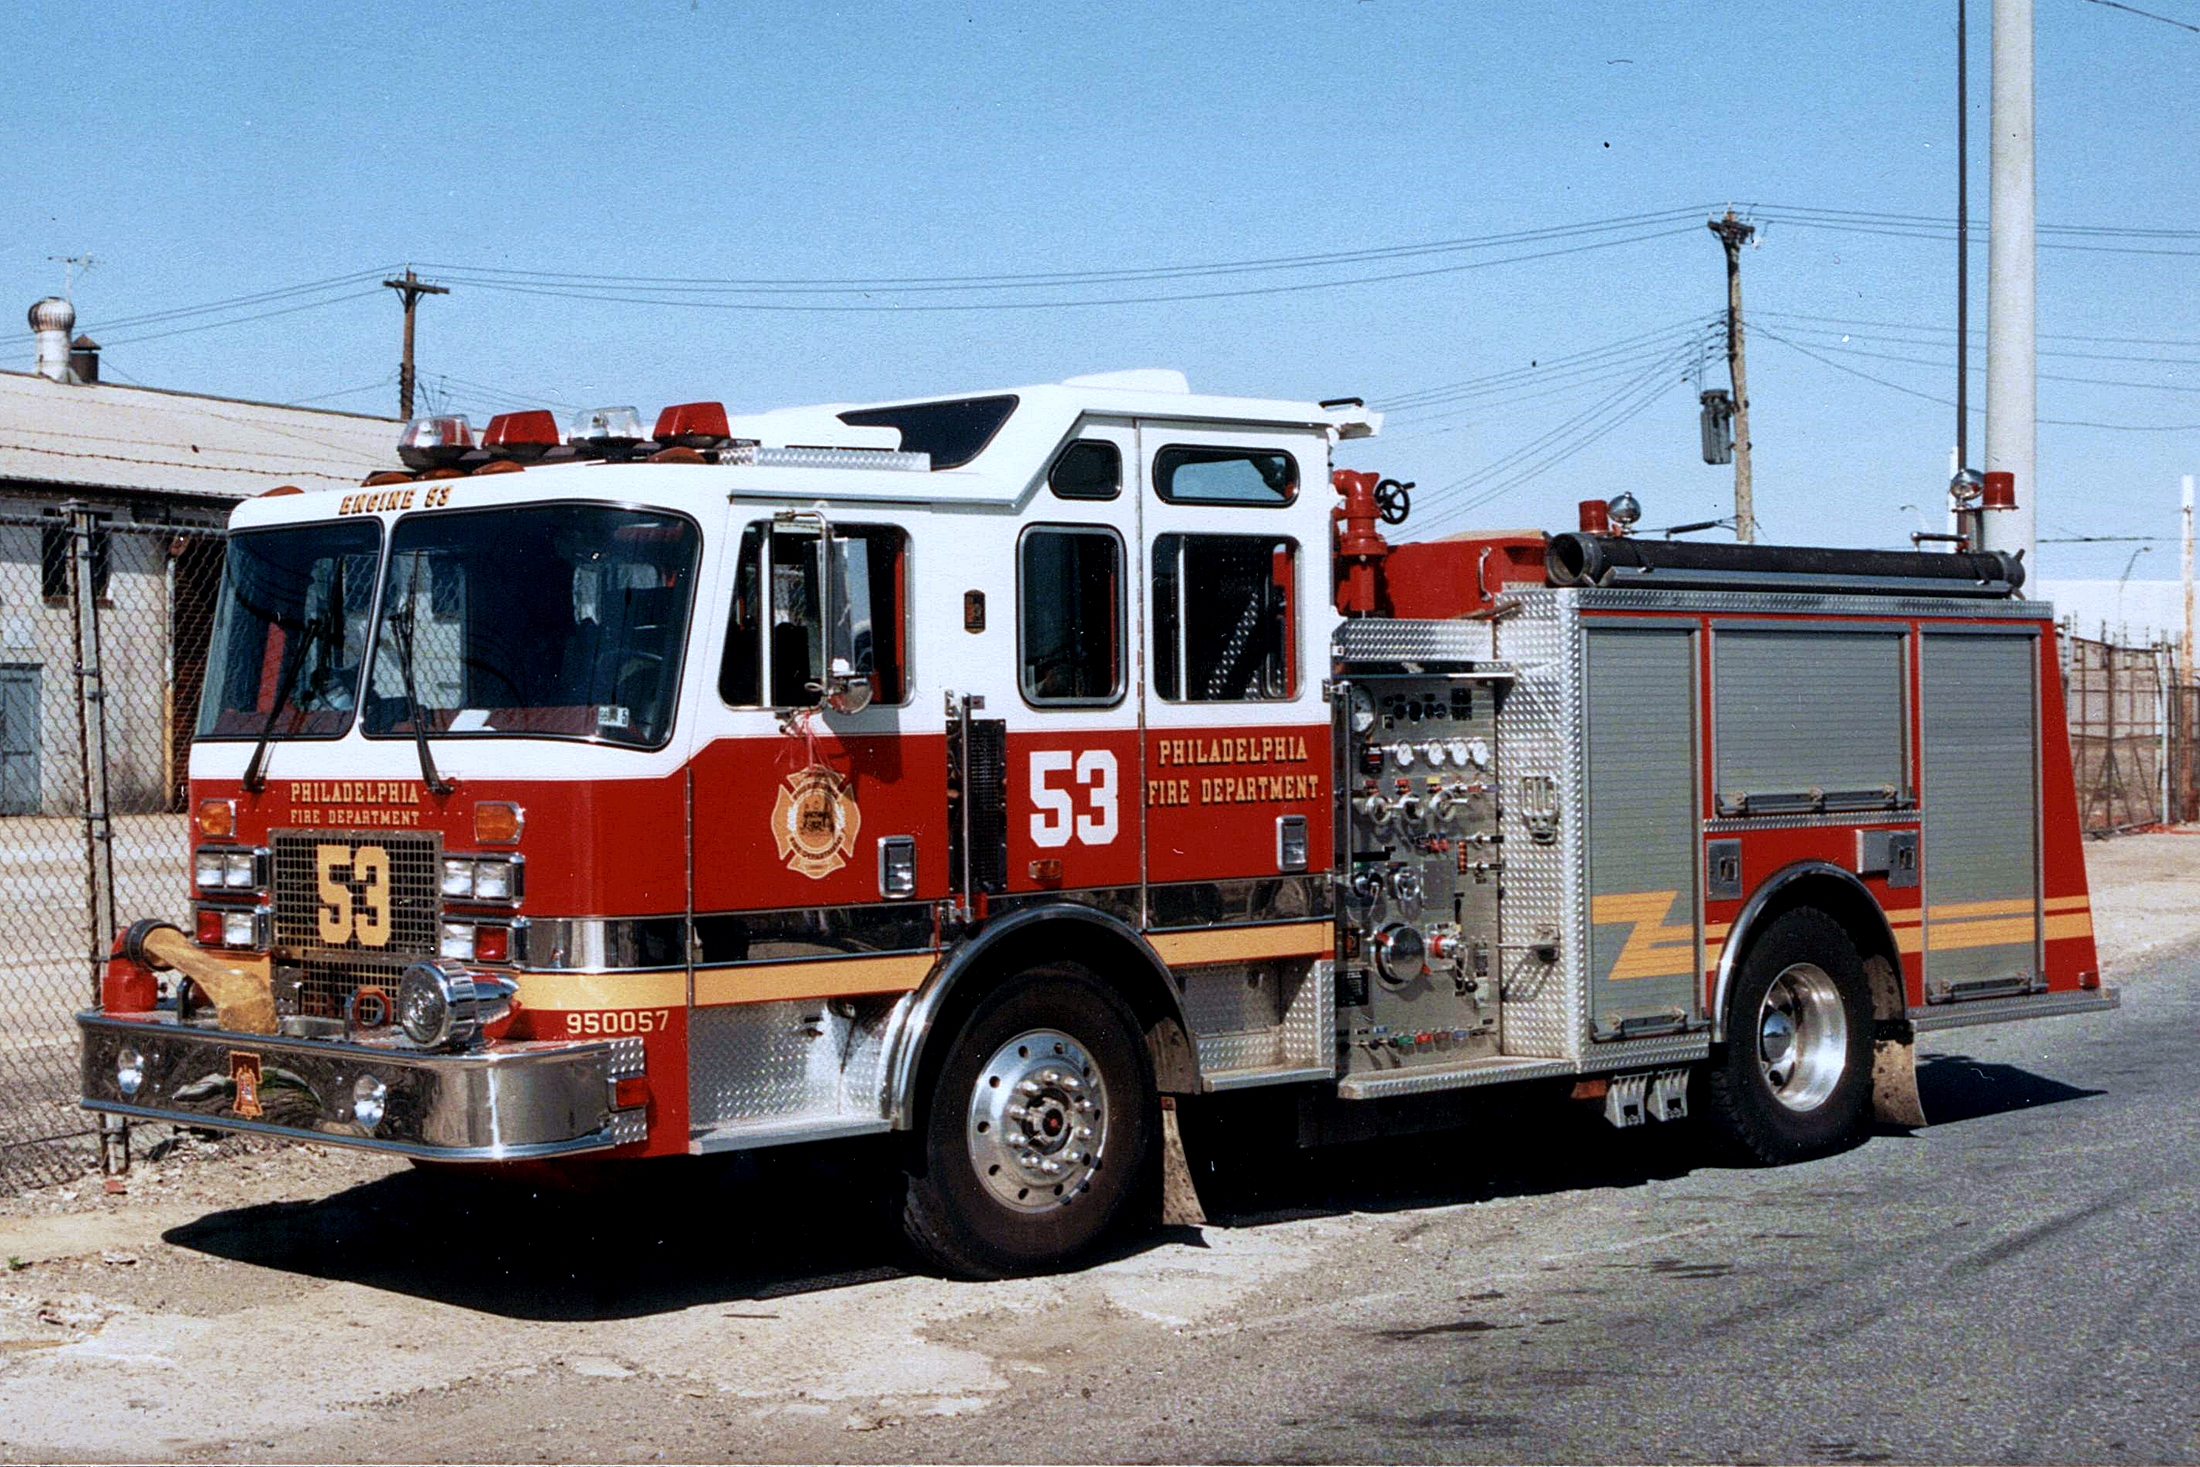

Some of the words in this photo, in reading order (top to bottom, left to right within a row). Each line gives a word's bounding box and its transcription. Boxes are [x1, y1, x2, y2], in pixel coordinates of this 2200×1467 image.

[338, 488, 416, 515] ENGINE
[424, 485, 454, 508] 53
[1158, 736, 1308, 766] PHILADELPHIA
[290, 782, 420, 804] PHILADELPHIA
[1029, 749, 1118, 848] 53
[1147, 779, 1190, 806] FIRE
[1200, 775, 1319, 804] DEPARTMENT
[290, 809, 320, 824] FIRE
[328, 810, 420, 826] DEPARTMENT
[317, 844, 391, 946] 53
[566, 1010, 669, 1034] 950057
